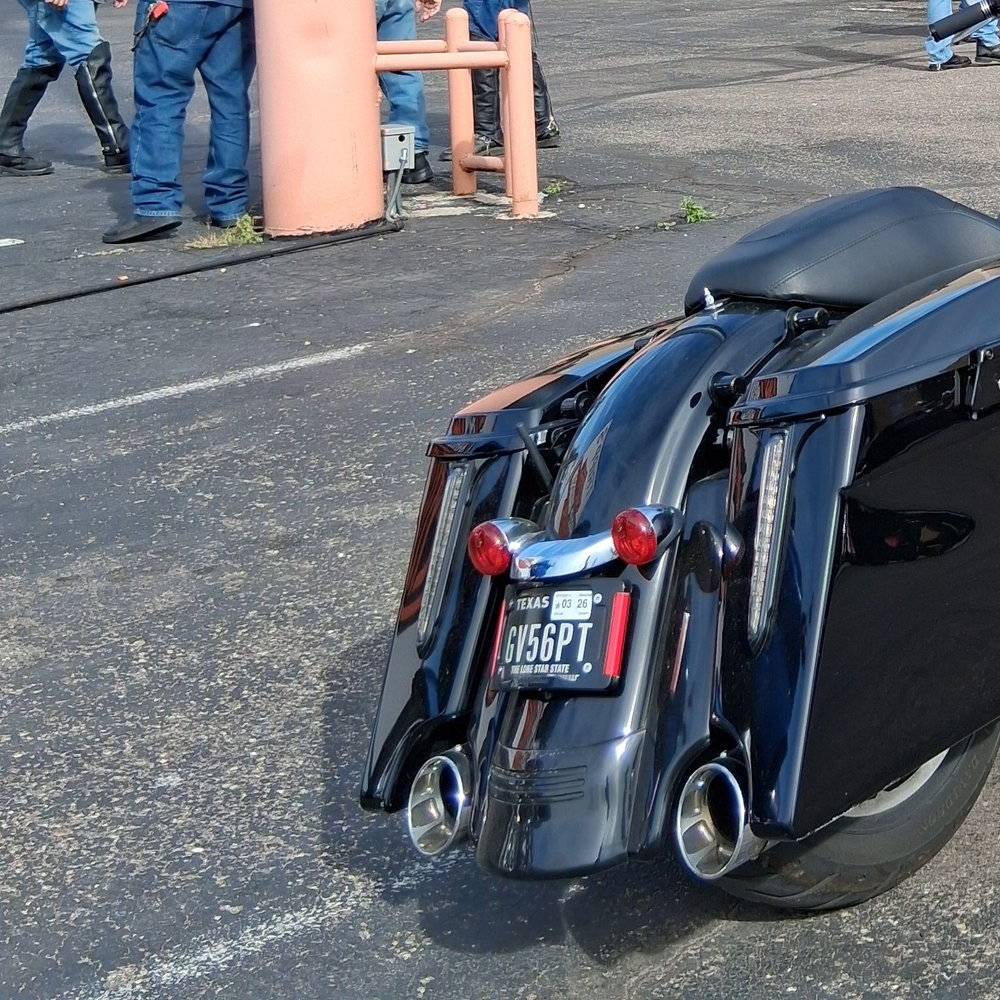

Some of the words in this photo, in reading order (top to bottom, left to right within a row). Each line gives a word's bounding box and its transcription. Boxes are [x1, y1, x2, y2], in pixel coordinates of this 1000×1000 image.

[516, 596, 550, 611] TEXAS
[561, 598, 572, 609] 03
[577, 598, 588, 609] 26
[504, 622, 594, 664] GV56PT
[520, 664, 534, 674] LONE
[534, 664, 549, 674] STAR
[549, 664, 570, 674] STATE
